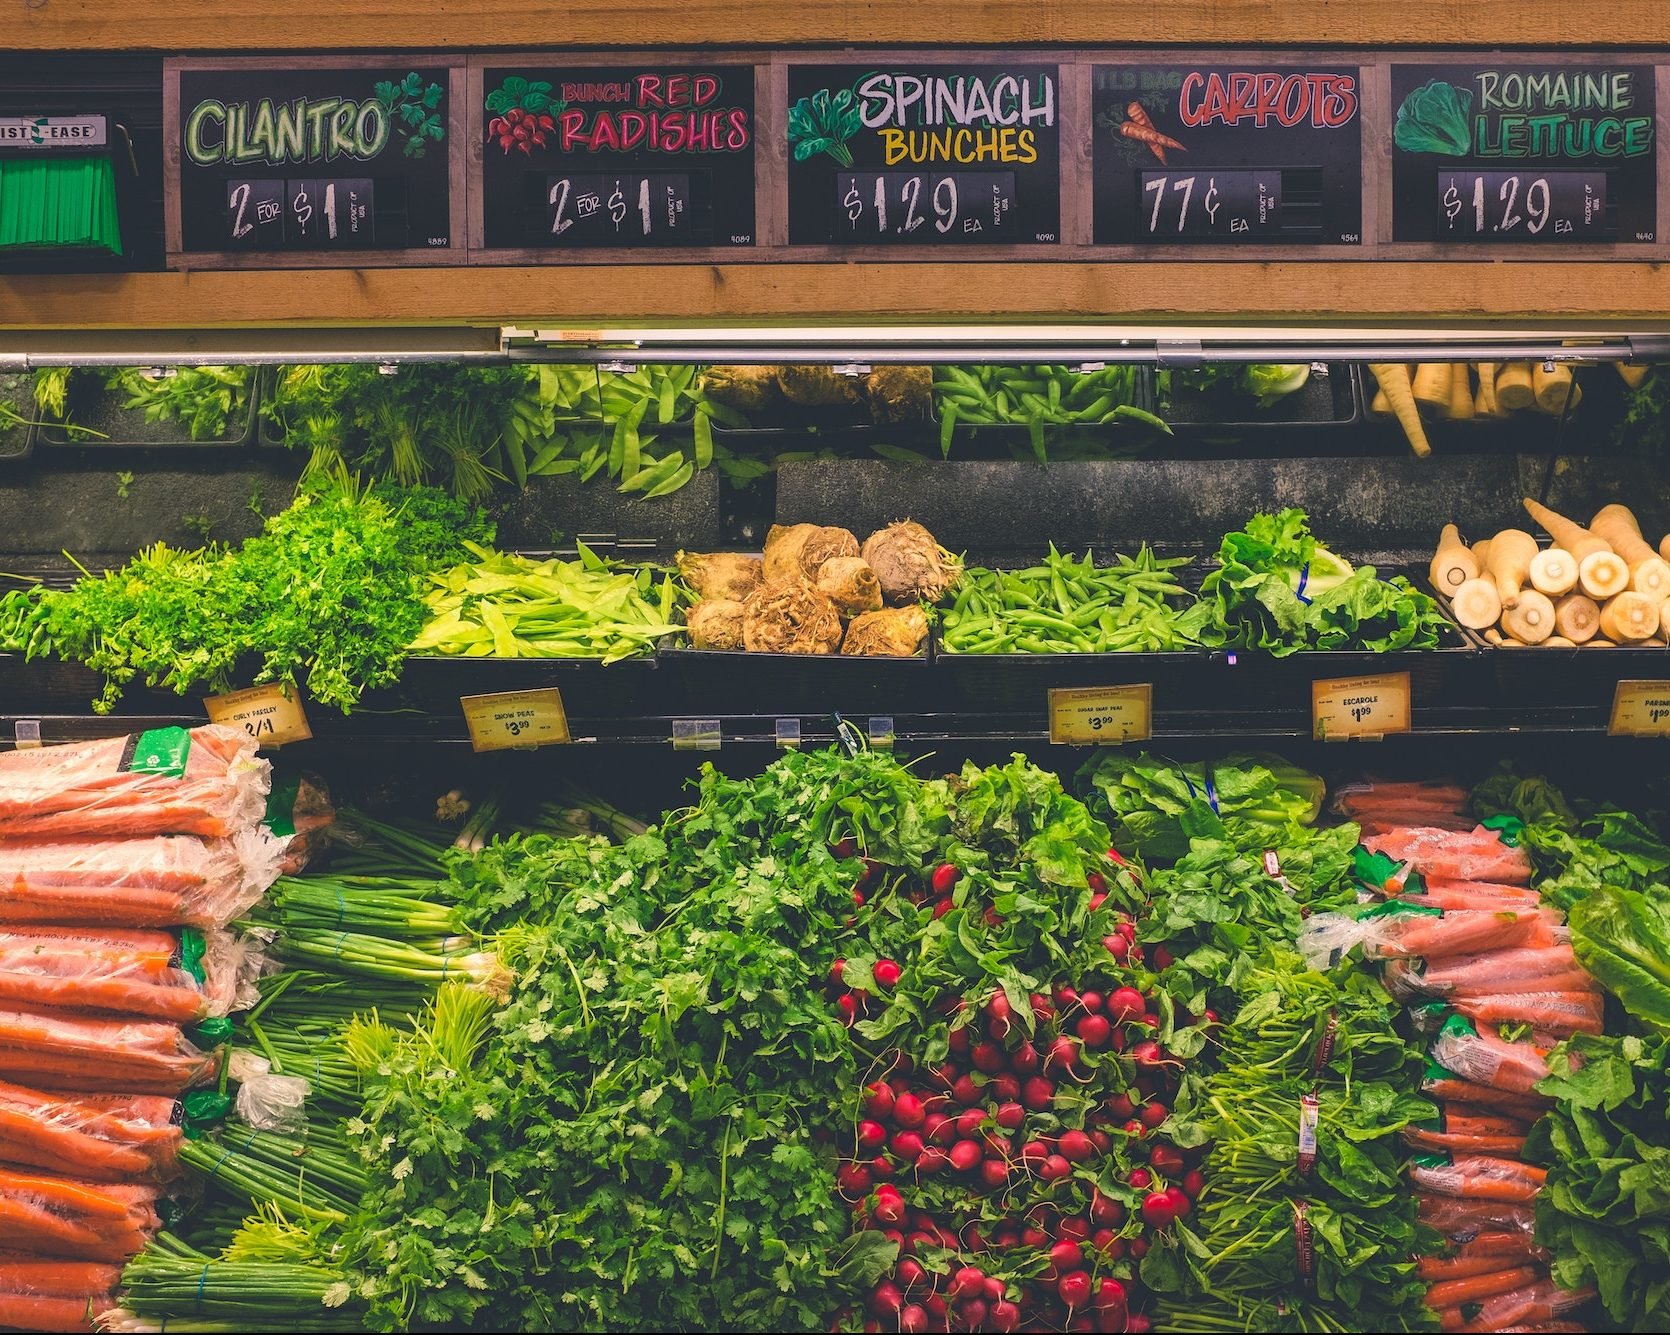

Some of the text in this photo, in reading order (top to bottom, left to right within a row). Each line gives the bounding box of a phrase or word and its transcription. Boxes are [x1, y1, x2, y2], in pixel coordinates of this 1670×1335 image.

[561, 73, 721, 109] BUNCH RED
[1474, 71, 1635, 112] ROMAINE
[857, 73, 1054, 128] SPINACH
[1180, 72, 1358, 128] CARROTS
[185, 96, 392, 167] CILANTRO
[559, 108, 750, 153] RADISHES
[1474, 114, 1654, 158] LETTUCE
[877, 127, 1038, 165] BUNCHES
[993, 184, 1000, 194] OF
[1259, 183, 1266, 192] OF
[1585, 184, 1592, 194] OF
[350, 191, 357, 201] OF
[229, 183, 254, 239] 2
[256, 199, 281, 224] FOR
[358, 205, 366, 218] USA
[550, 179, 574, 235] 2
[576, 193, 601, 217] FOR
[667, 186, 675, 227] PRODUCT OF
[675, 199, 683, 213] USA
[1001, 198, 1009, 211] USA
[1145, 176, 1249, 233] 77¢ EA
[964, 218, 983, 233] EA
[1554, 219, 1573, 233] EA
[427, 237, 448, 246] 4889
[731, 235, 750, 243] 4089
[1035, 233, 1055, 241] 4090
[1340, 233, 1358, 242] 4564
[1635, 232, 1654, 240] 4640
[1343, 696, 1378, 706] ESCAROLE
[233, 712, 251, 722] CURLY
[252, 706, 277, 717] PARSLEY
[494, 712, 515, 720] SNOW
